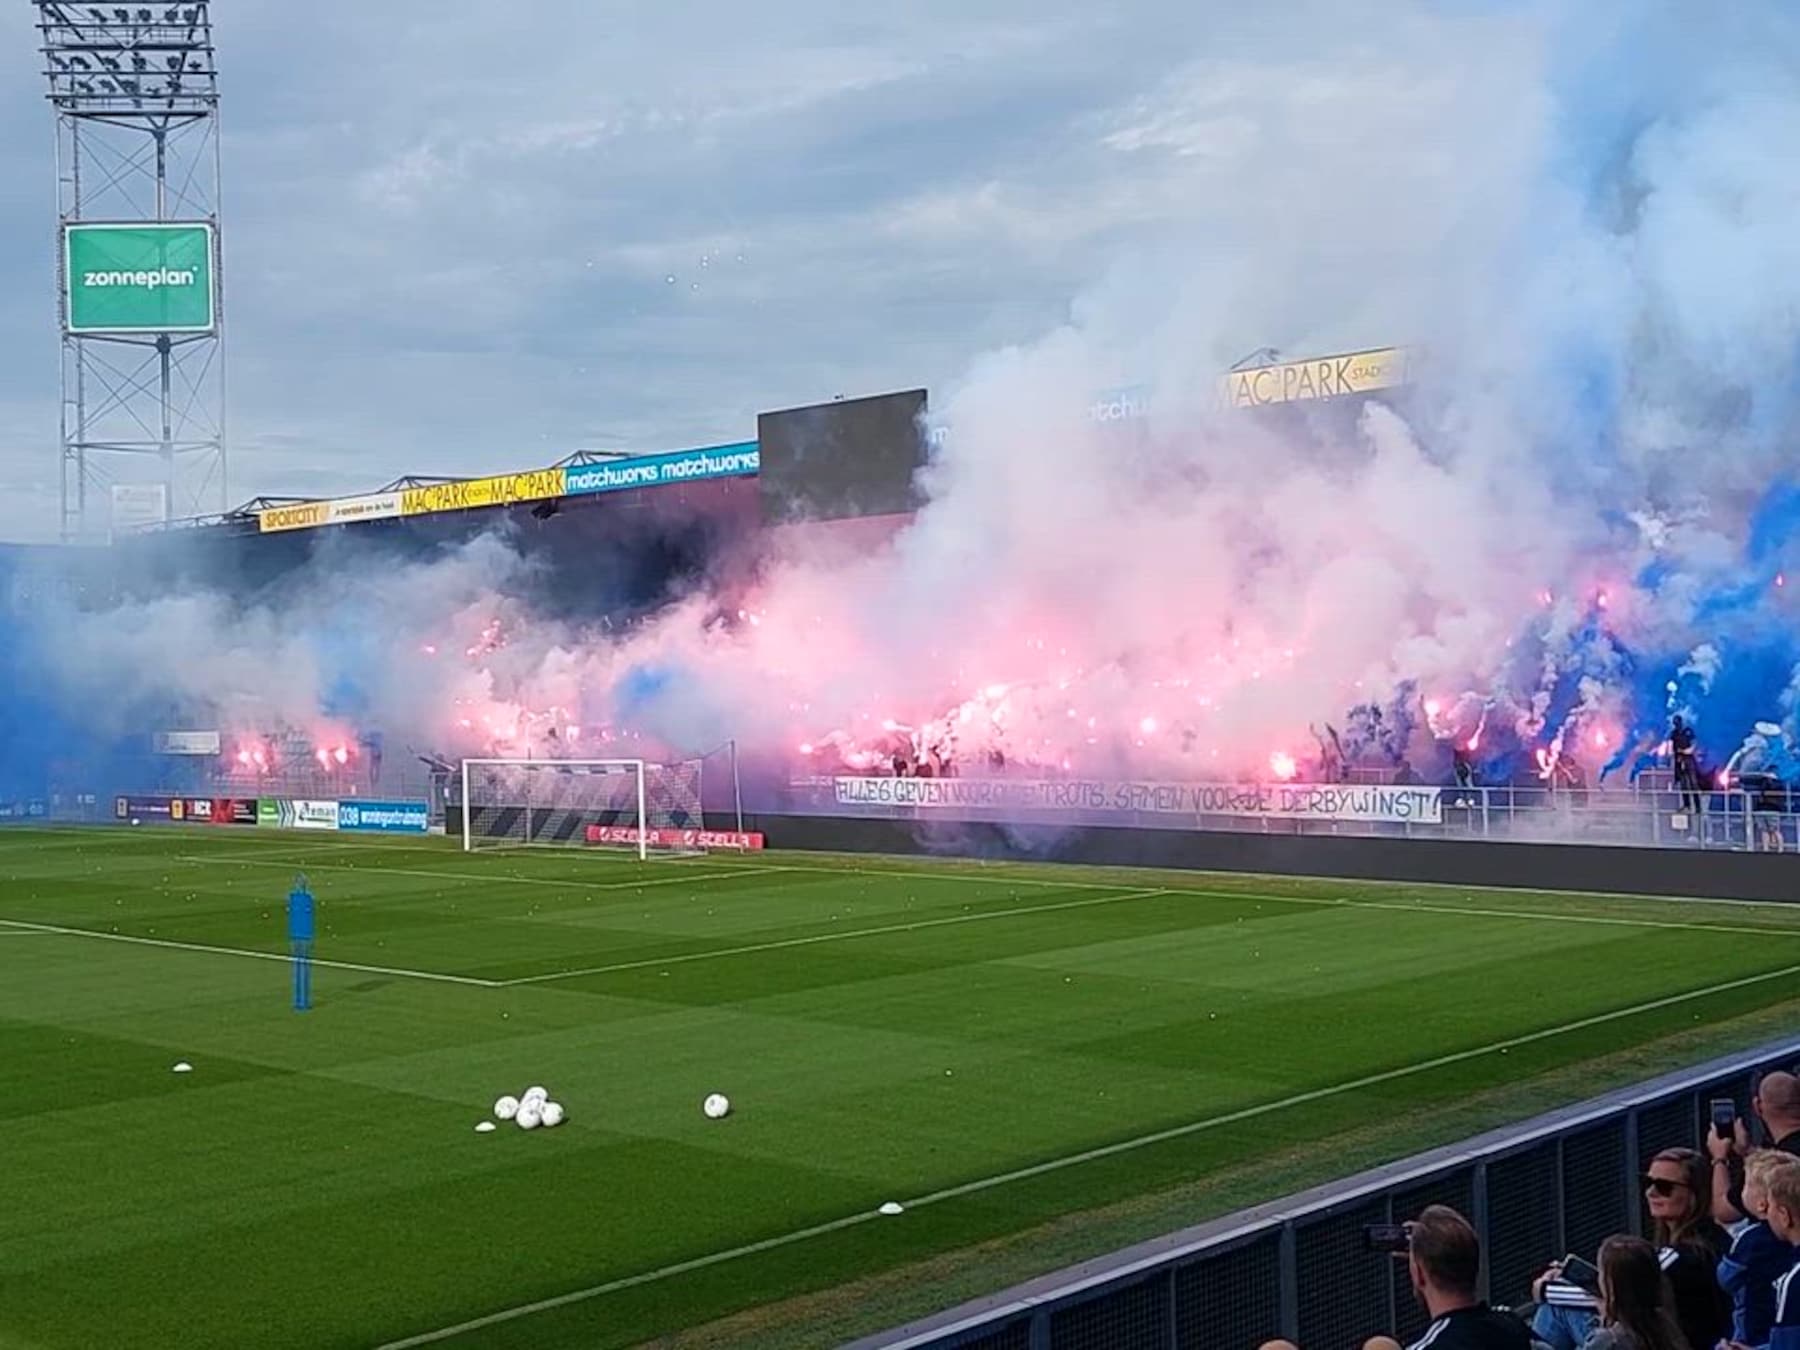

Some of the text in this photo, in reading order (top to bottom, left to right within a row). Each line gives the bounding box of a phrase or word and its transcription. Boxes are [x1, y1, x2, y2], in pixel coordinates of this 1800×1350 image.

[84, 266, 194, 290] zonneplan
[567, 451, 760, 490] matchworks matchworks
[265, 505, 319, 528] SPORTCITY
